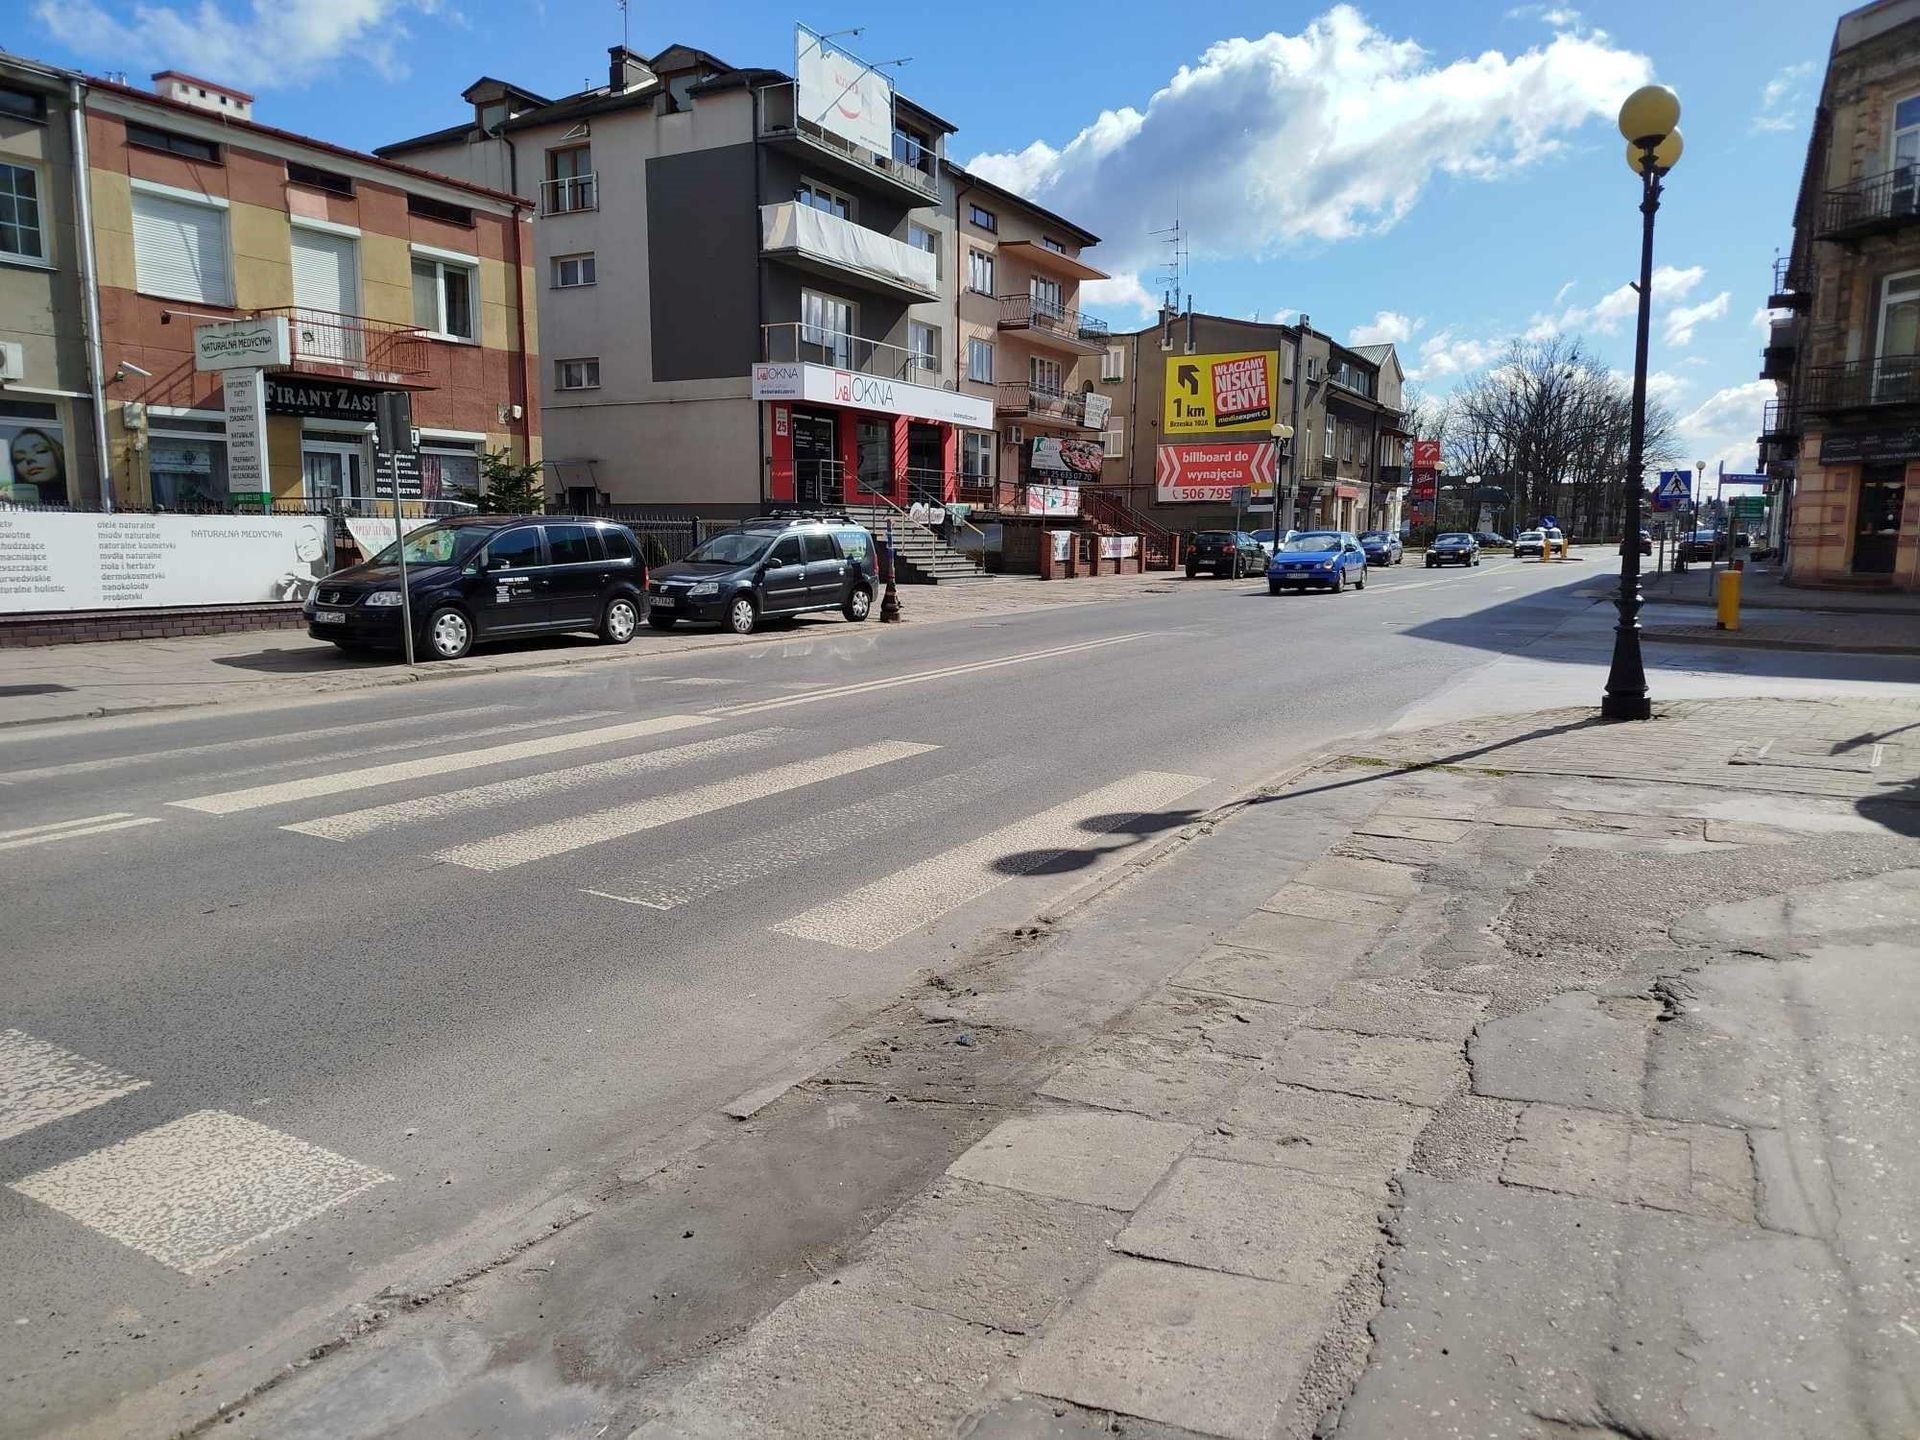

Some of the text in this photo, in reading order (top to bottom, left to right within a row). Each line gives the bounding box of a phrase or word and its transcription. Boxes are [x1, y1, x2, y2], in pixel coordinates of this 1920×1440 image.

[201, 335, 272, 352] NATURALNA MEDYCYNA
[769, 367, 798, 379] OKNA
[1215, 368, 1264, 393] NISKIE
[264, 381, 377, 412] FIRANY ZASŁ
[852, 377, 894, 407] OKNA
[1217, 385, 1267, 412] CENY!
[1173, 397, 1206, 418] 1 km
[1218, 411, 1261, 424] mediaexpert
[777, 420, 787, 433] 25
[1182, 451, 1249, 463] billboard do
[1187, 468, 1243, 481] wynajęcia
[1182, 488, 1205, 500] 506
[1209, 487, 1232, 500] 795
[119, 521, 156, 529] naturalne
[191, 530, 283, 538] NATURALNA MEDYCYNA
[99, 542, 176, 550] naturalne kosmetyki
[126, 562, 156, 570] herbaty
[101, 573, 165, 581] dermokosmetyki
[34, 584, 65, 593] holistic
